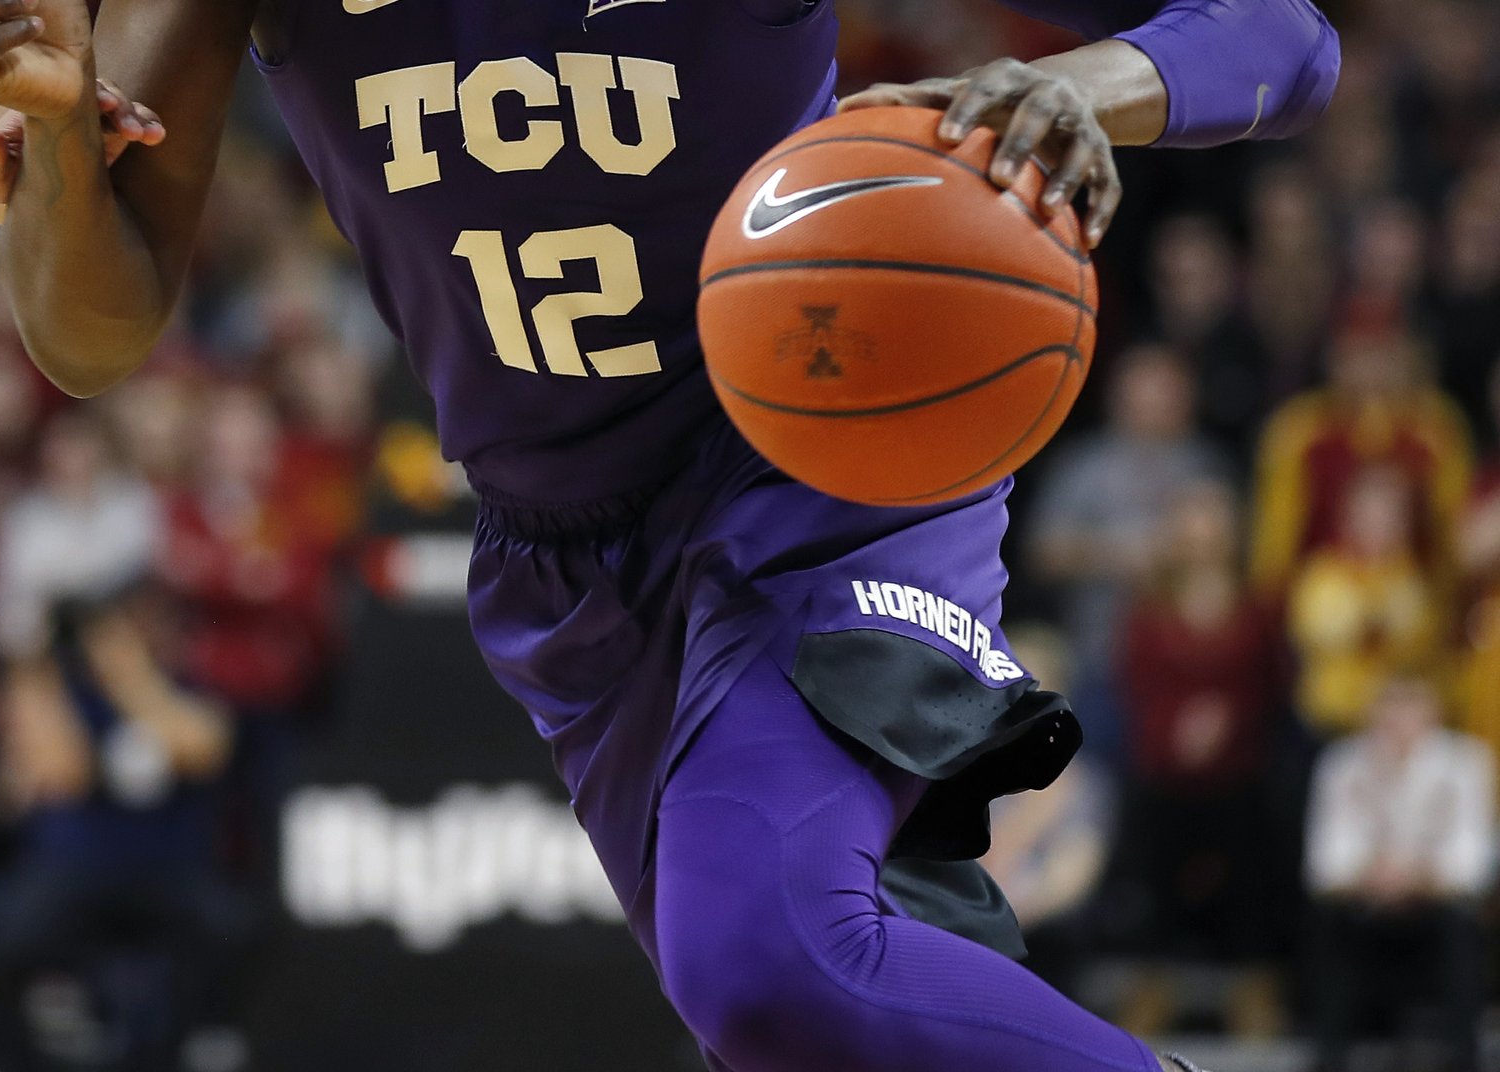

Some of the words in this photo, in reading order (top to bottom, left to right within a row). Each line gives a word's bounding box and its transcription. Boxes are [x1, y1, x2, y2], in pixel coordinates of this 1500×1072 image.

[355, 52, 680, 193] TCU
[451, 223, 661, 378] 12
[851, 580, 972, 652] HORNED
